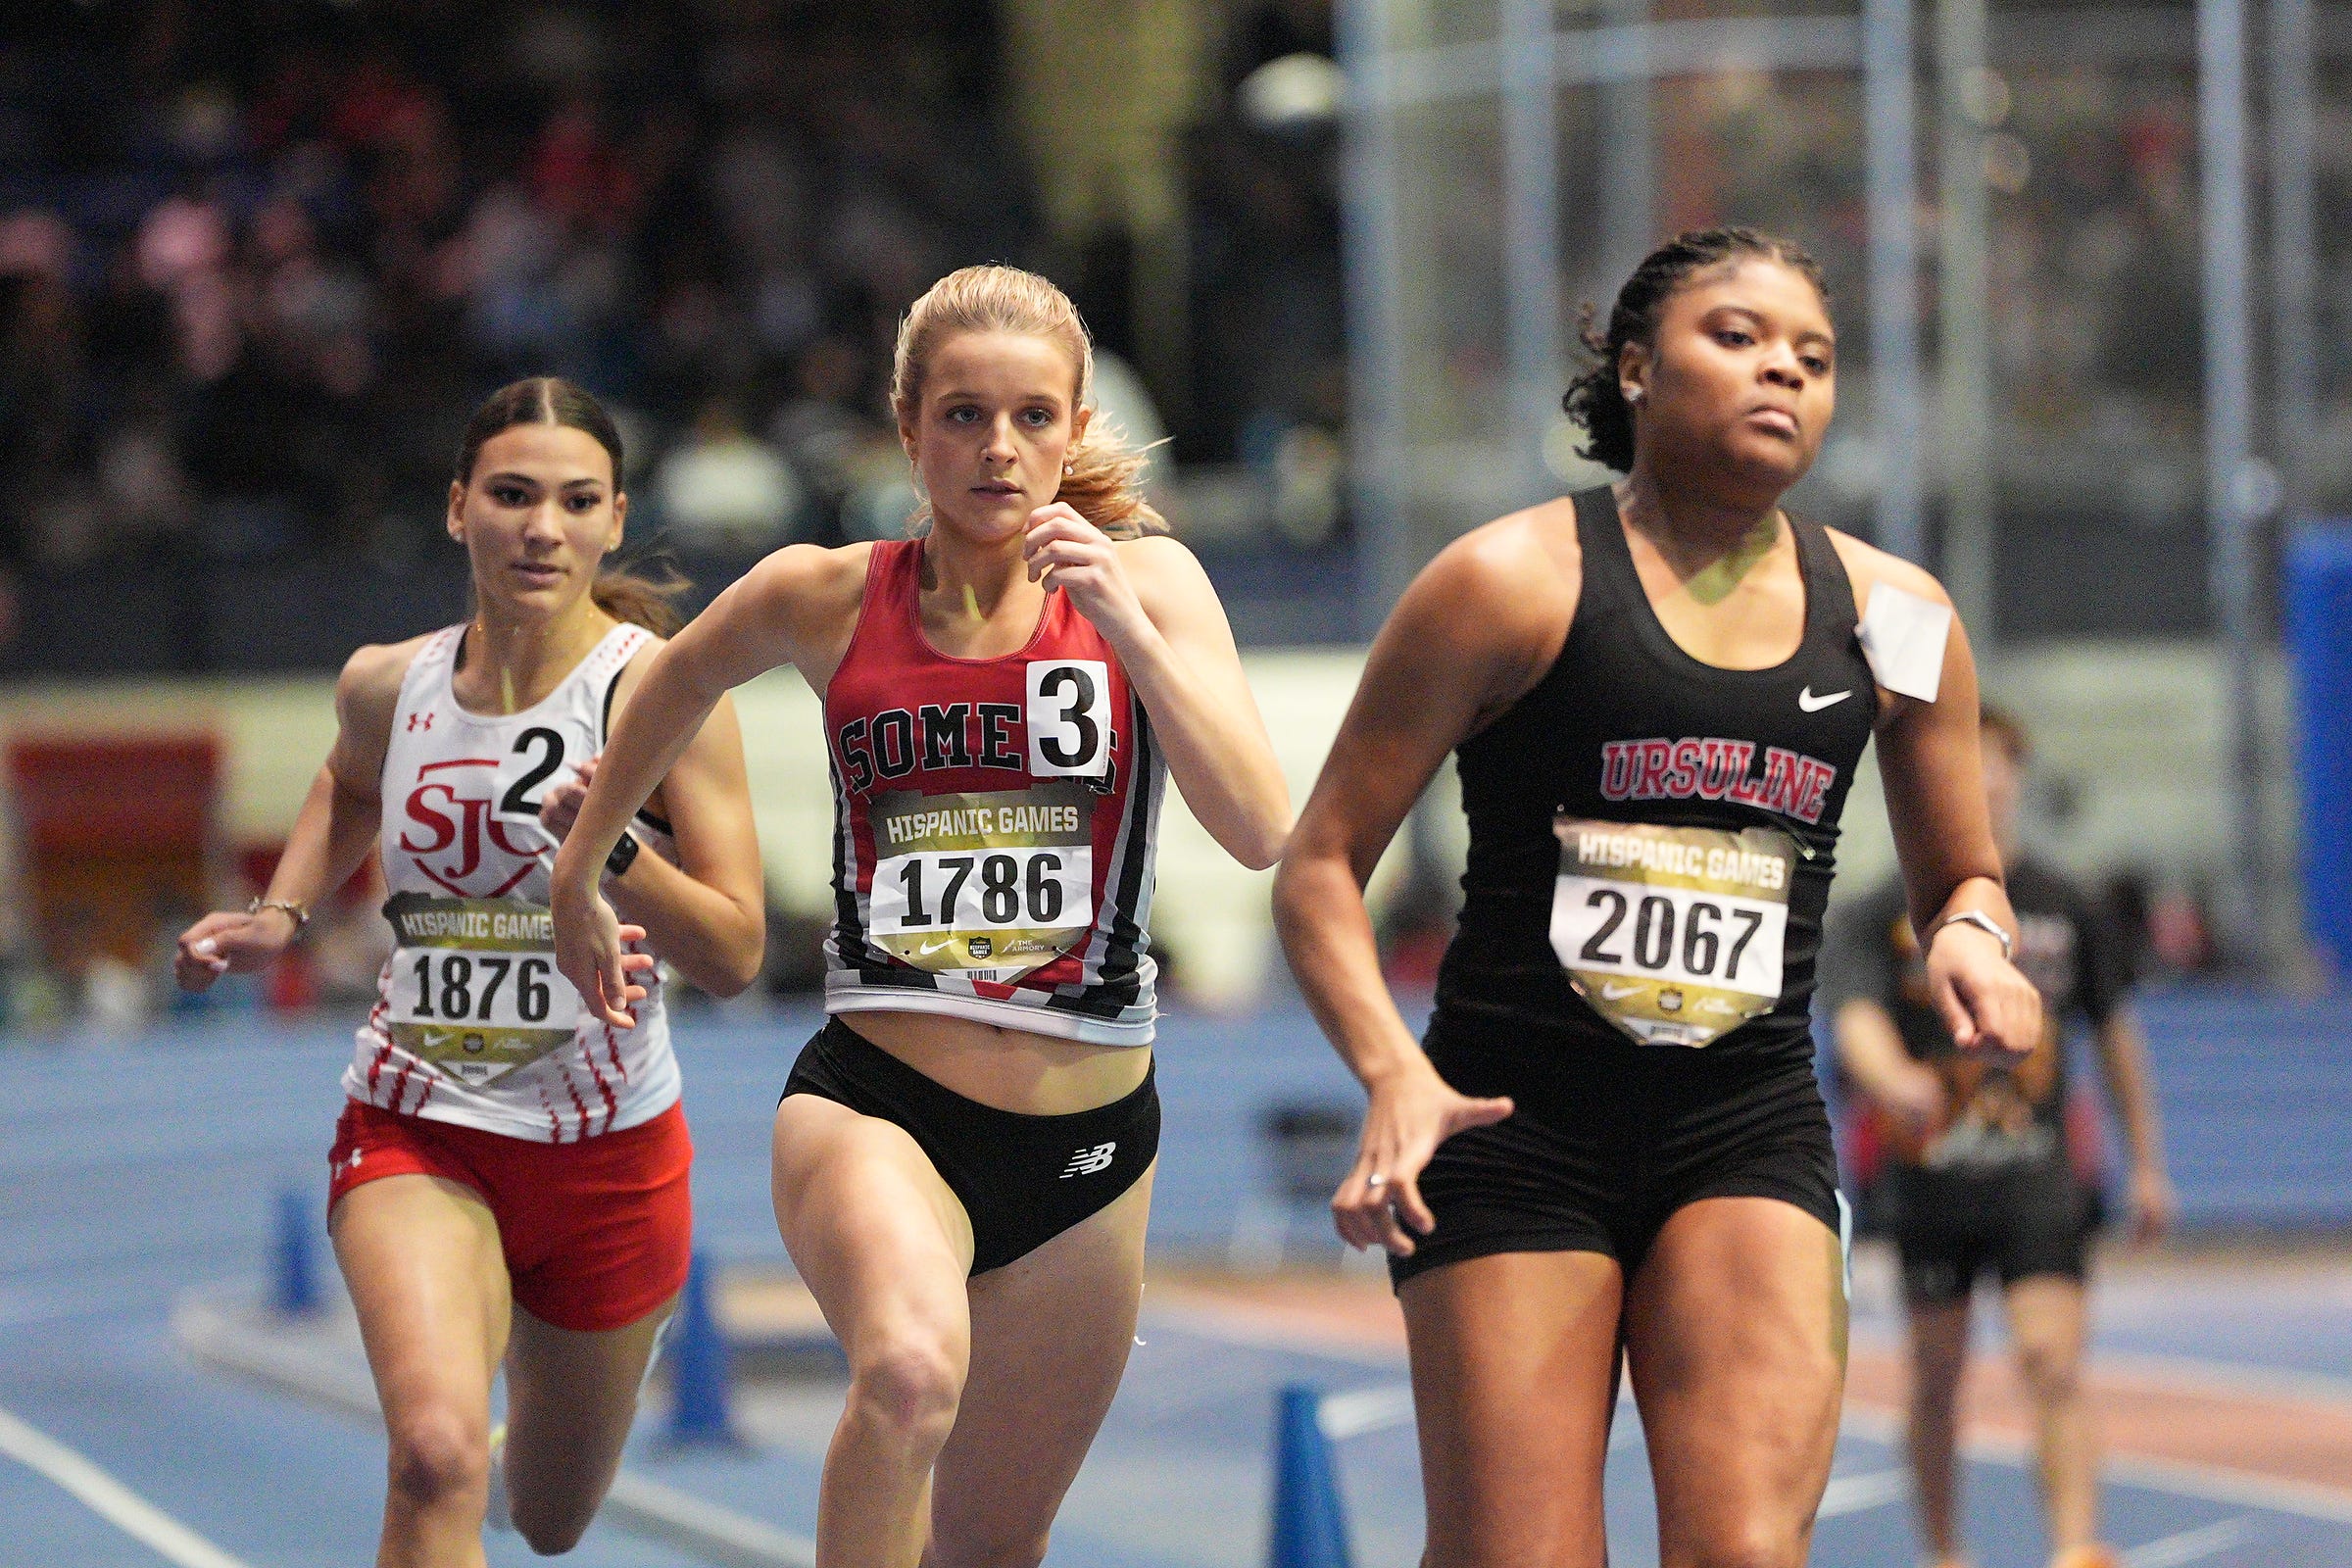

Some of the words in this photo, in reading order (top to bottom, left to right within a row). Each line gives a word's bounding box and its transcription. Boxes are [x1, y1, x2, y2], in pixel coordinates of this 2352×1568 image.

[839, 702, 1117, 795] SOME
[1039, 666, 1099, 767] 3
[499, 726, 565, 816] 2
[1601, 736, 1838, 825] URSULINE
[886, 808, 993, 844] HISPANIC
[998, 806, 1079, 834] GAMES
[1578, 832, 1704, 876] HISPANIC
[1707, 848, 1787, 891] GAMES
[401, 911, 489, 938] HISPANIC
[493, 913, 555, 940] GAME
[900, 853, 1063, 927] 1786
[1579, 890, 1763, 980] 2067
[413, 955, 551, 1022] 1876
